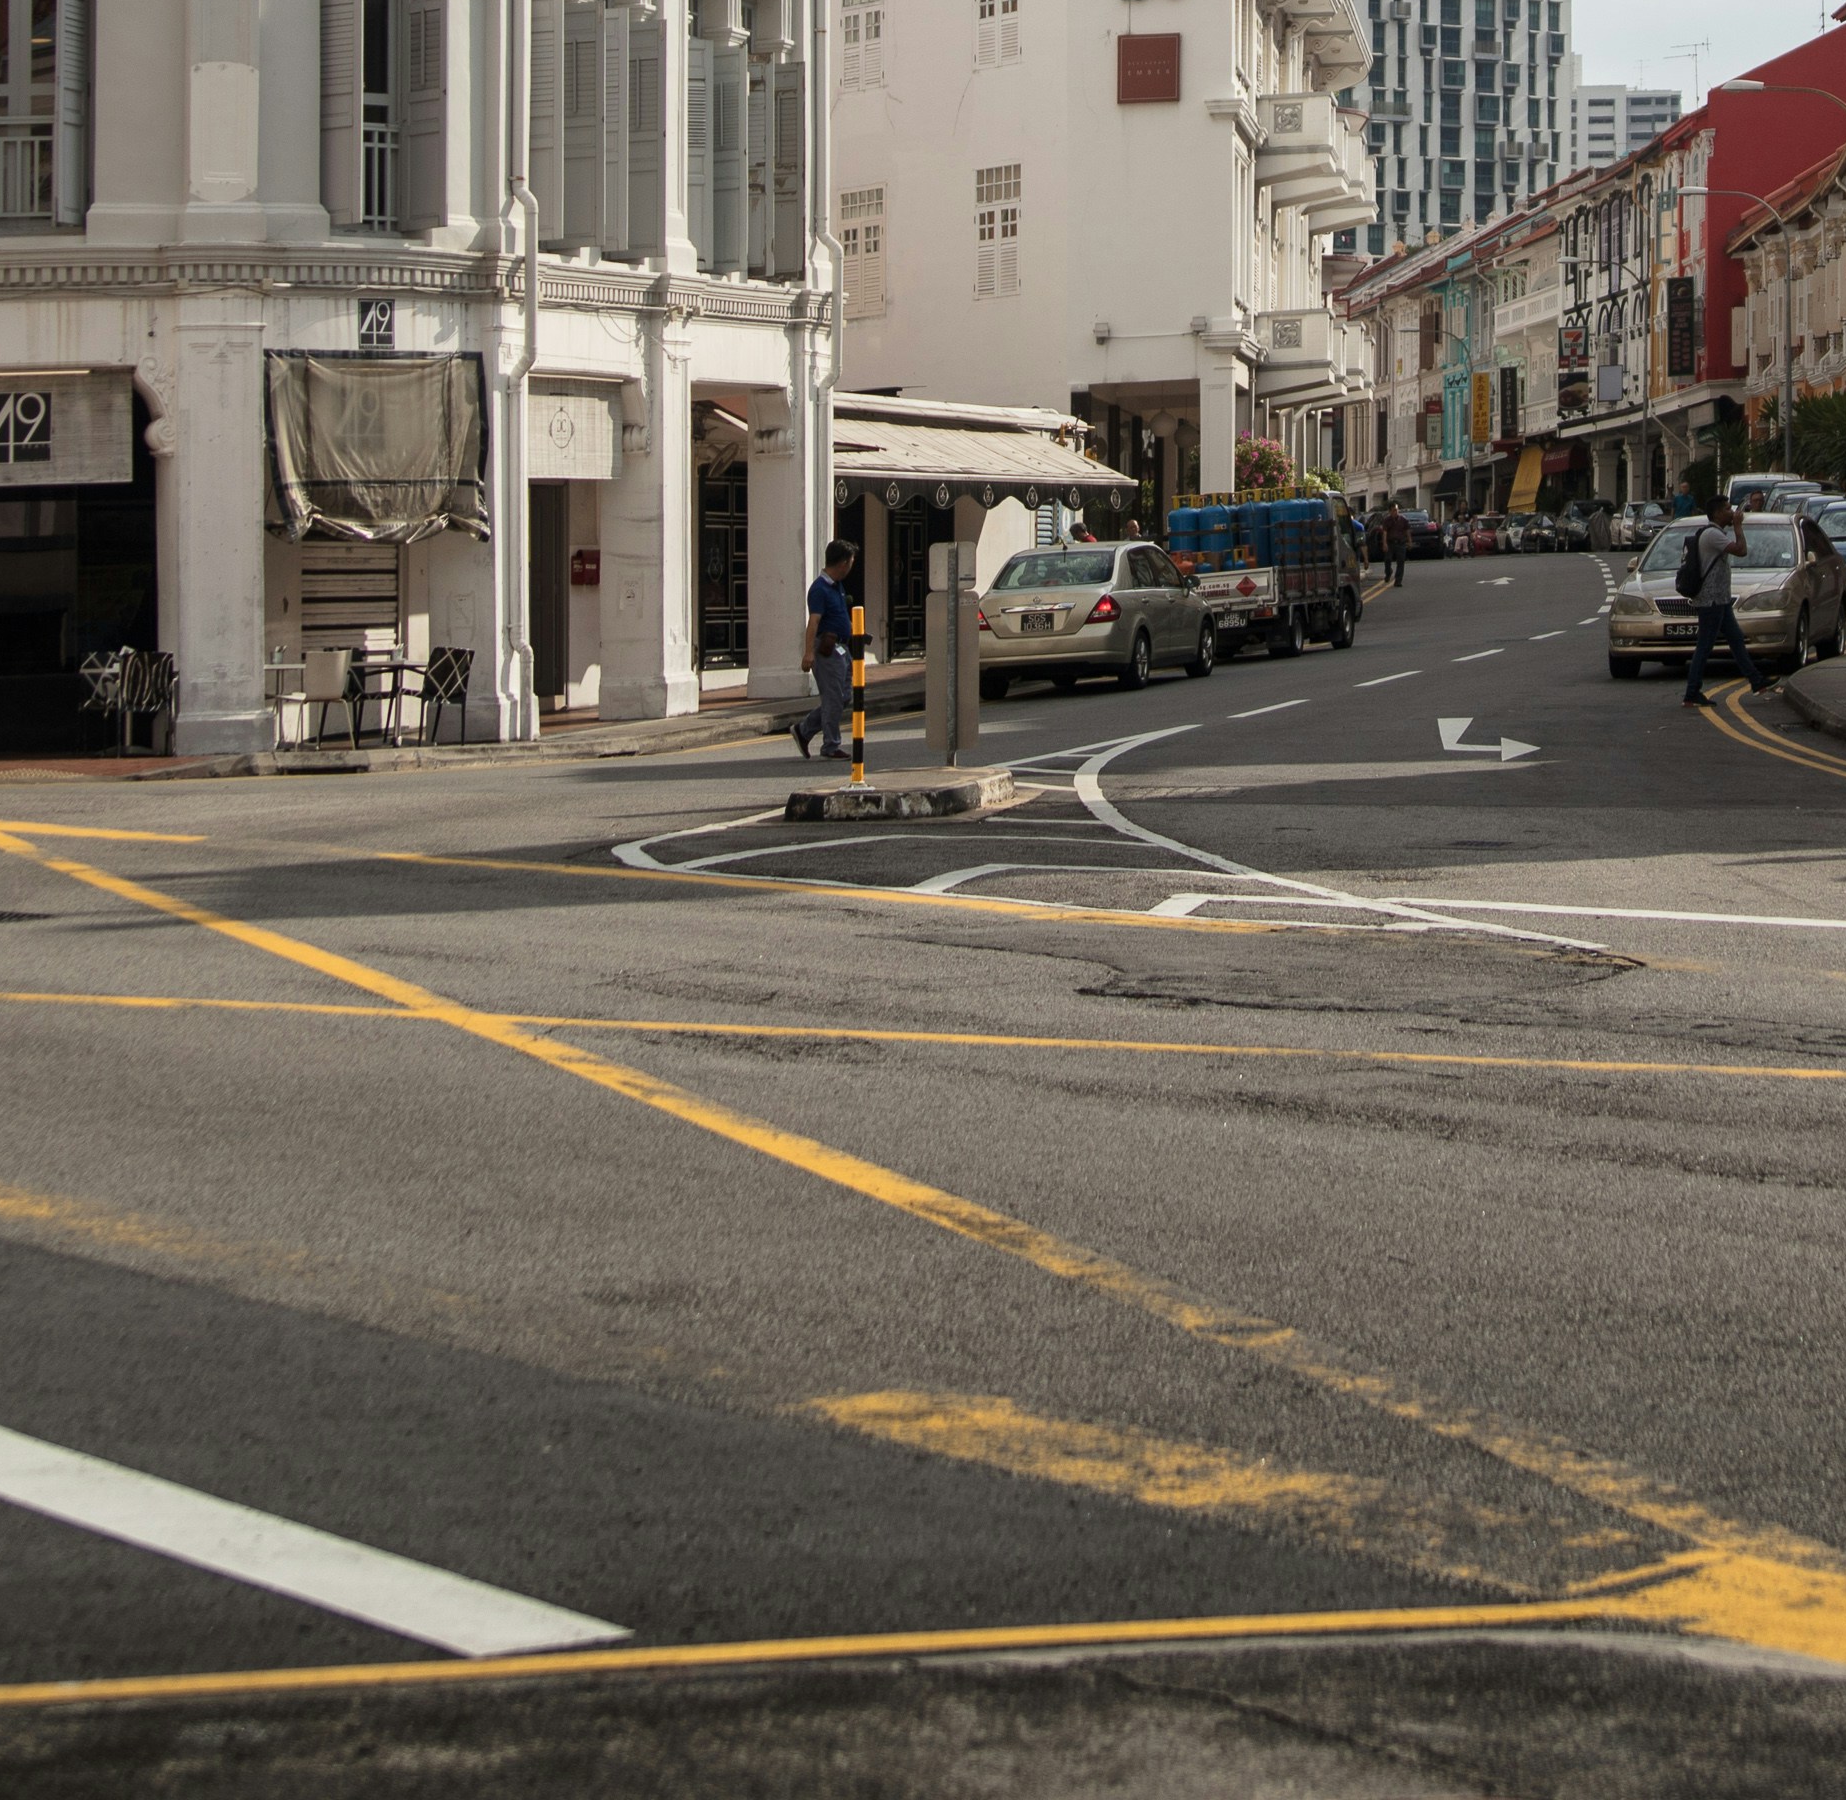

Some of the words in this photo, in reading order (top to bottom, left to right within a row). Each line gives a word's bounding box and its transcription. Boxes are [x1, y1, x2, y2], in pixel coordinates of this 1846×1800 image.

[1127, 69, 1171, 77] EMBER
[360, 301, 392, 345] 49
[1028, 613, 1046, 623] SGS
[1218, 618, 1246, 628] 6895U
[1023, 621, 1051, 631] 1036H
